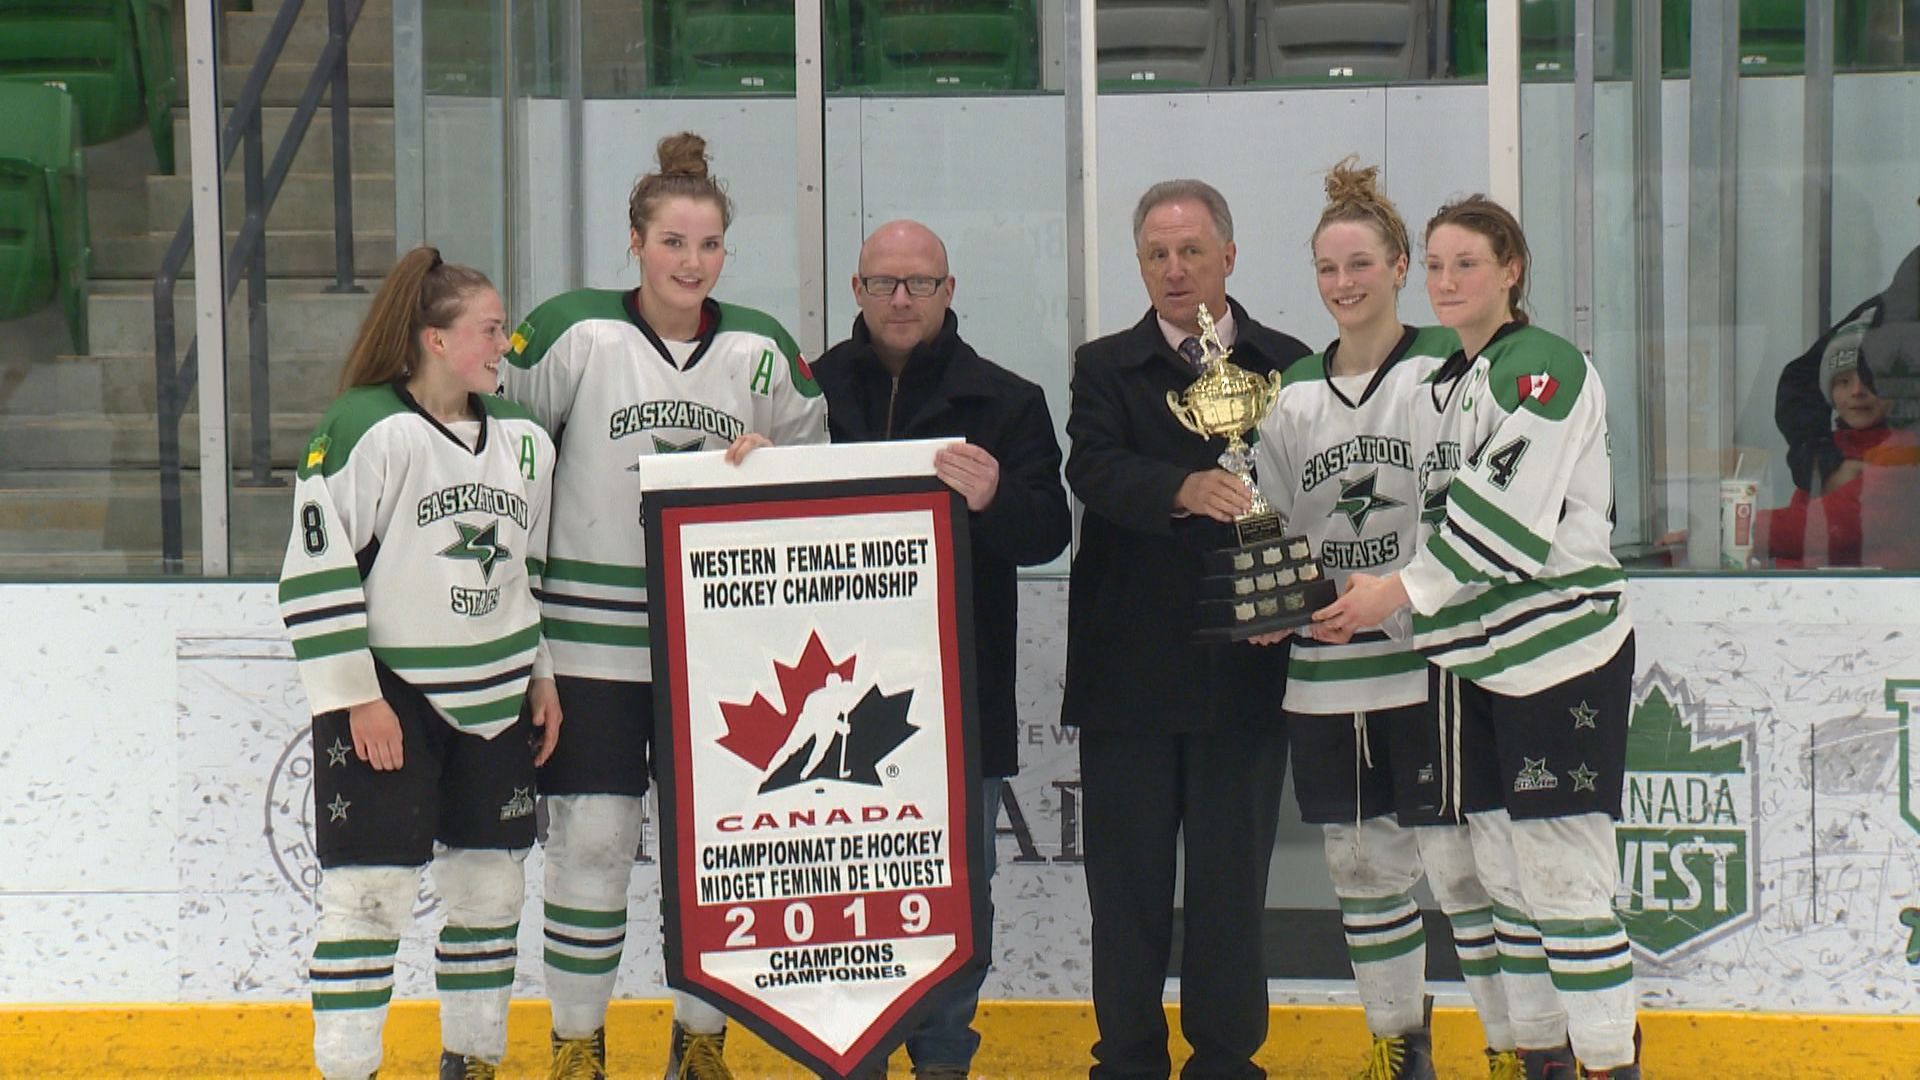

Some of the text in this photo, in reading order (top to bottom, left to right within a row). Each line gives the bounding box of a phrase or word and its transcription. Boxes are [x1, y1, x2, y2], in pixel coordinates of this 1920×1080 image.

[750, 349, 775, 396] A
[609, 400, 744, 443] SASKATOON
[519, 435, 536, 480] A
[1464, 431, 1532, 493] 14
[417, 483, 528, 530] SASKATOON
[301, 500, 328, 557] 8
[1321, 531, 1399, 569] STARS
[690, 538, 929, 578] WESTERN FEMALE MIDGET
[703, 571, 919, 609] HOCKEY CHAMPIONSHIP
[716, 804, 923, 833] CANADA
[1629, 777, 1738, 824] NADA
[702, 829, 943, 870] CHAMPIONNAT DE HOCKEY
[700, 858, 945, 902] MIDGET FEMININ DE L'OUEST
[724, 893, 931, 947] 2019
[755, 965, 907, 989] CHAMPIONNES
[769, 943, 894, 970] CHAMPIONS
